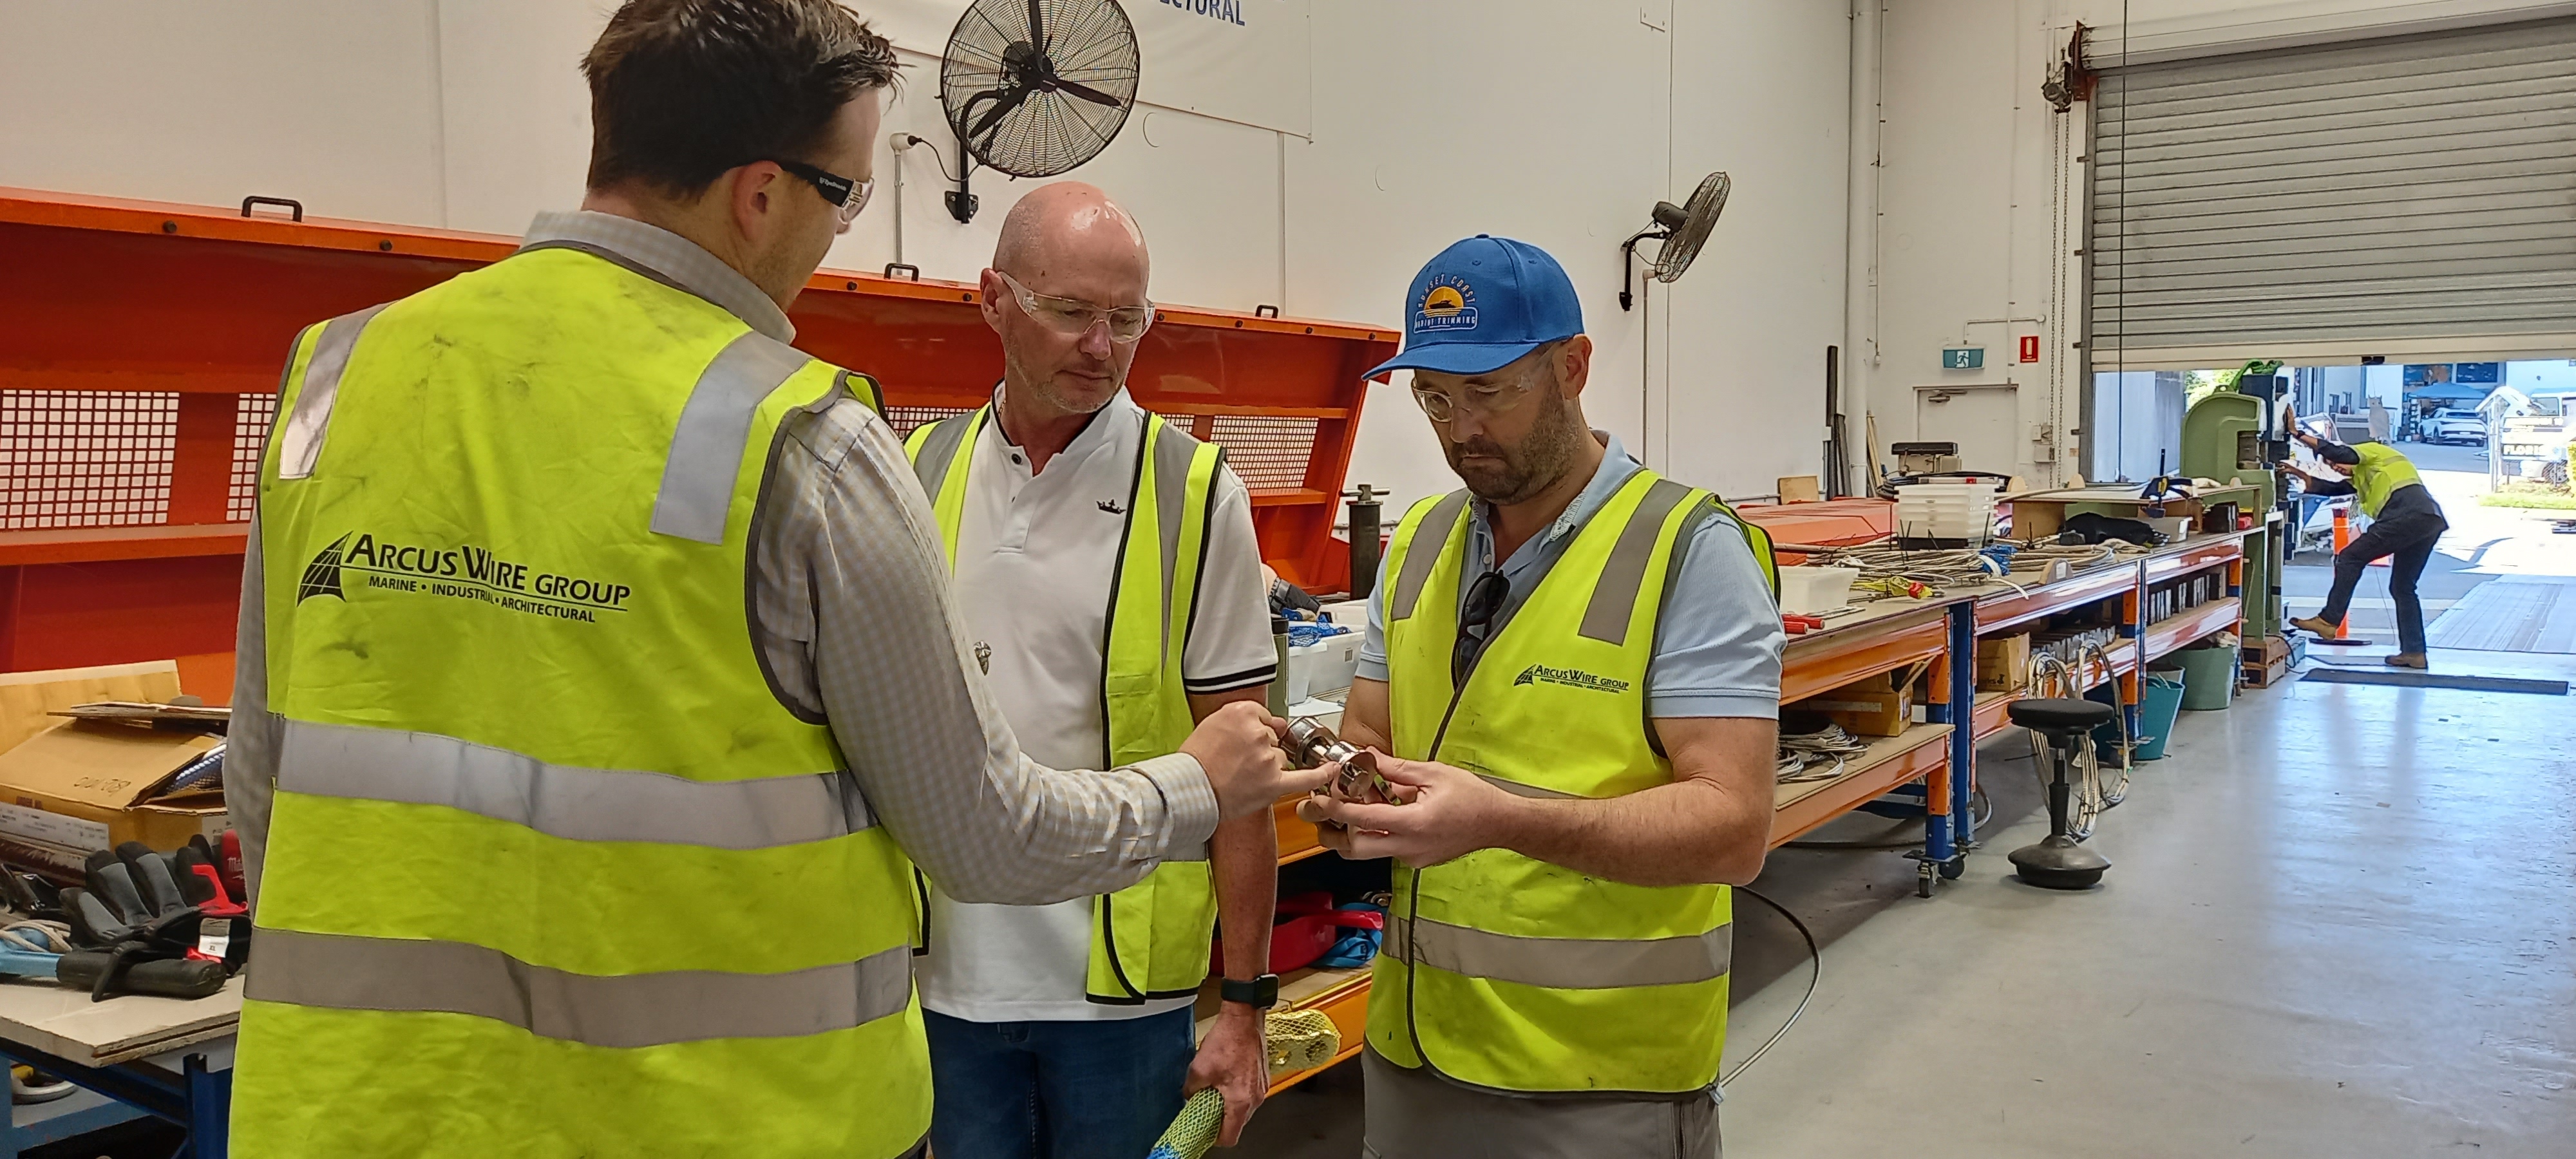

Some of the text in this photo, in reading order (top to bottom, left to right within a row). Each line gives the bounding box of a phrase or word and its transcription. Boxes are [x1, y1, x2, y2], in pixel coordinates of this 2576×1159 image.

[1159, 0, 1245, 26] URAL
[1451, 276, 1475, 303] COAST
[1438, 316, 1475, 325] TRIMMING
[345, 534, 630, 605] ARCUS WIRE GROUP
[368, 576, 596, 623] MARINE INDUSTRIAL ARCHITECTURAL
[1534, 664, 1629, 689] ARCUS WIRE GROUP
